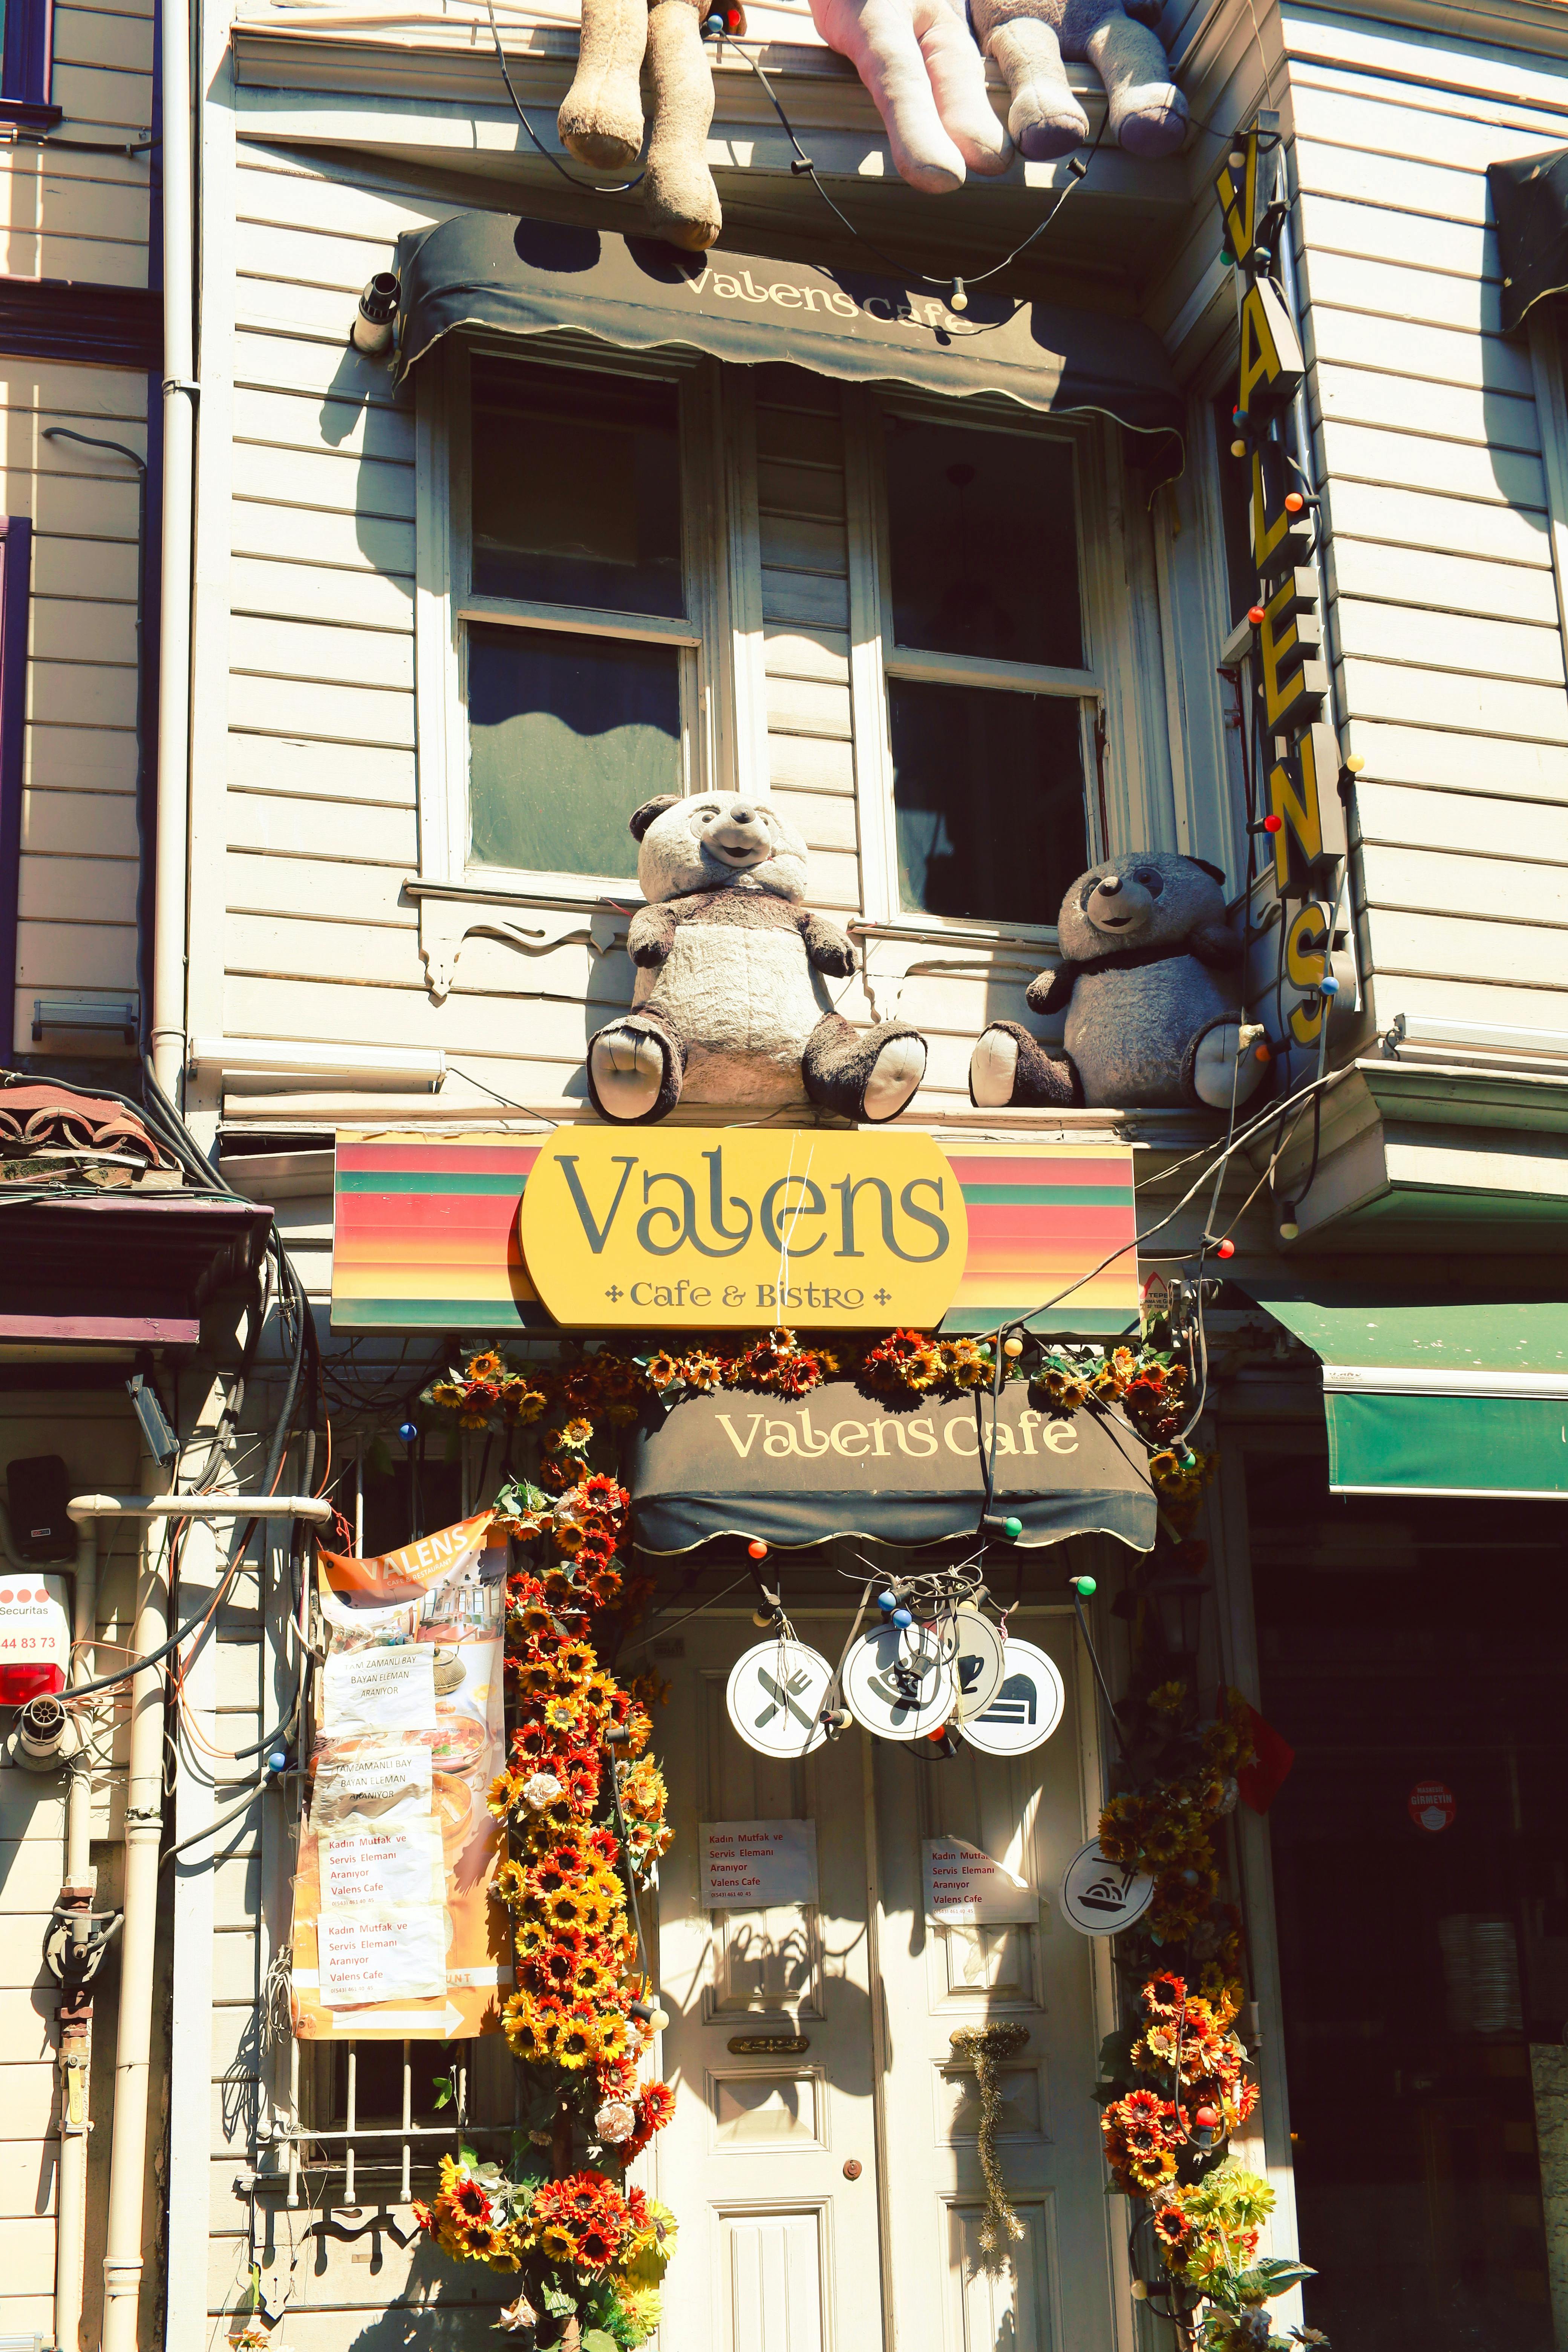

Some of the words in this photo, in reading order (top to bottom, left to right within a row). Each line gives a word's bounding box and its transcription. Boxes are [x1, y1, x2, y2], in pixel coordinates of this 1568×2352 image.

[1214, 117, 1341, 1050] VALENS
[553, 1145, 949, 1263] Valens
[631, 1280, 712, 1306] Cafe
[722, 1285, 746, 1307] &
[359, 1526, 468, 1580] VALENS
[412, 1558, 452, 1580] RESTAURANT
[0, 1606, 48, 1615] Securitas
[0, 1638, 17, 1649] 44
[21, 1638, 36, 1648] 83
[41, 1637, 55, 1648] 73
[402, 1656, 416, 1664] BAY
[351, 1675, 377, 1684] BAYAN
[380, 1671, 409, 1681] ELEMAN
[361, 1686, 398, 1697] ARANIYOR
[396, 1759, 412, 1767] BAY
[341, 1778, 367, 1787] BAYAN
[371, 1775, 405, 1785] ELEMAN
[1411, 1793, 1452, 1805] GİRMEYİN
[329, 1840, 354, 1849] Kadın
[360, 1835, 391, 1846] Mutfak
[709, 1835, 733, 1844] Kadın
[738, 1833, 769, 1842] Mutfak
[330, 1856, 356, 1865] Servis
[361, 1853, 397, 1862] Elemanı
[710, 1864, 747, 1873] Aranıyor
[330, 1870, 369, 1880] Aranıyor
[331, 1886, 361, 1895] Valens
[364, 1883, 383, 1892] Cafe
[711, 1879, 739, 1887] Valens
[933, 1881, 969, 1890] Aranıyor
[329, 1926, 354, 1936] Kadın
[360, 1922, 392, 1933] Mutfak
[329, 1942, 356, 1951] Servis
[361, 1940, 397, 1949] Elemanı
[330, 1956, 369, 1966] Aranıyor
[330, 1972, 360, 1981] Valens
[363, 1970, 383, 1979] Cafe
